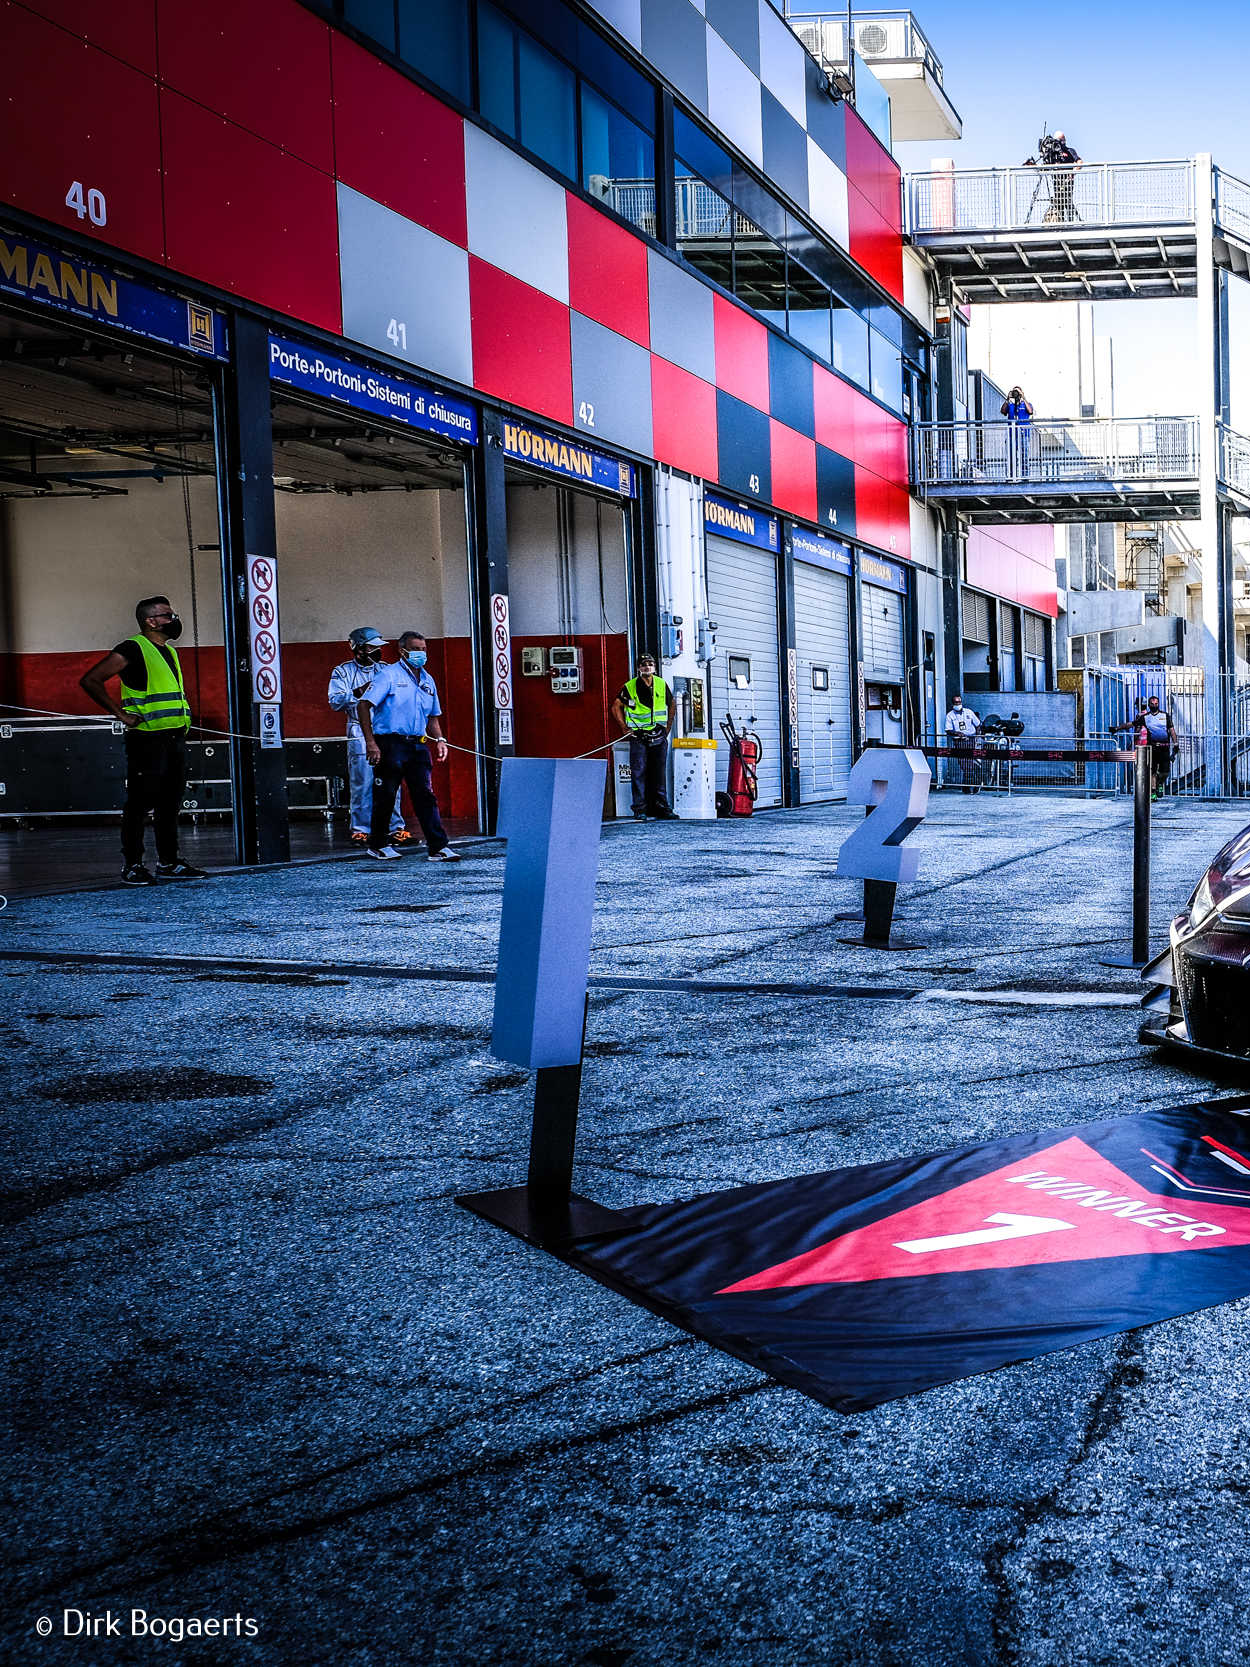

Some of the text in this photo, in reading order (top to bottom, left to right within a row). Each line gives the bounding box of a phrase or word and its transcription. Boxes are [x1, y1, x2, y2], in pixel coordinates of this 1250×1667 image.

[65, 181, 107, 227] 40
[386, 318, 407, 350] 41
[414, 397, 425, 415] di
[428, 402, 472, 431] chiusura
[579, 401, 595, 427] 42
[504, 424, 593, 478] HÖRMANN
[749, 474, 760, 494] 43
[828, 508, 838, 525] 44
[837, 748, 932, 882] 2
[1004, 1170, 1228, 1242] WINNER
[893, 1211, 1079, 1256] 1
